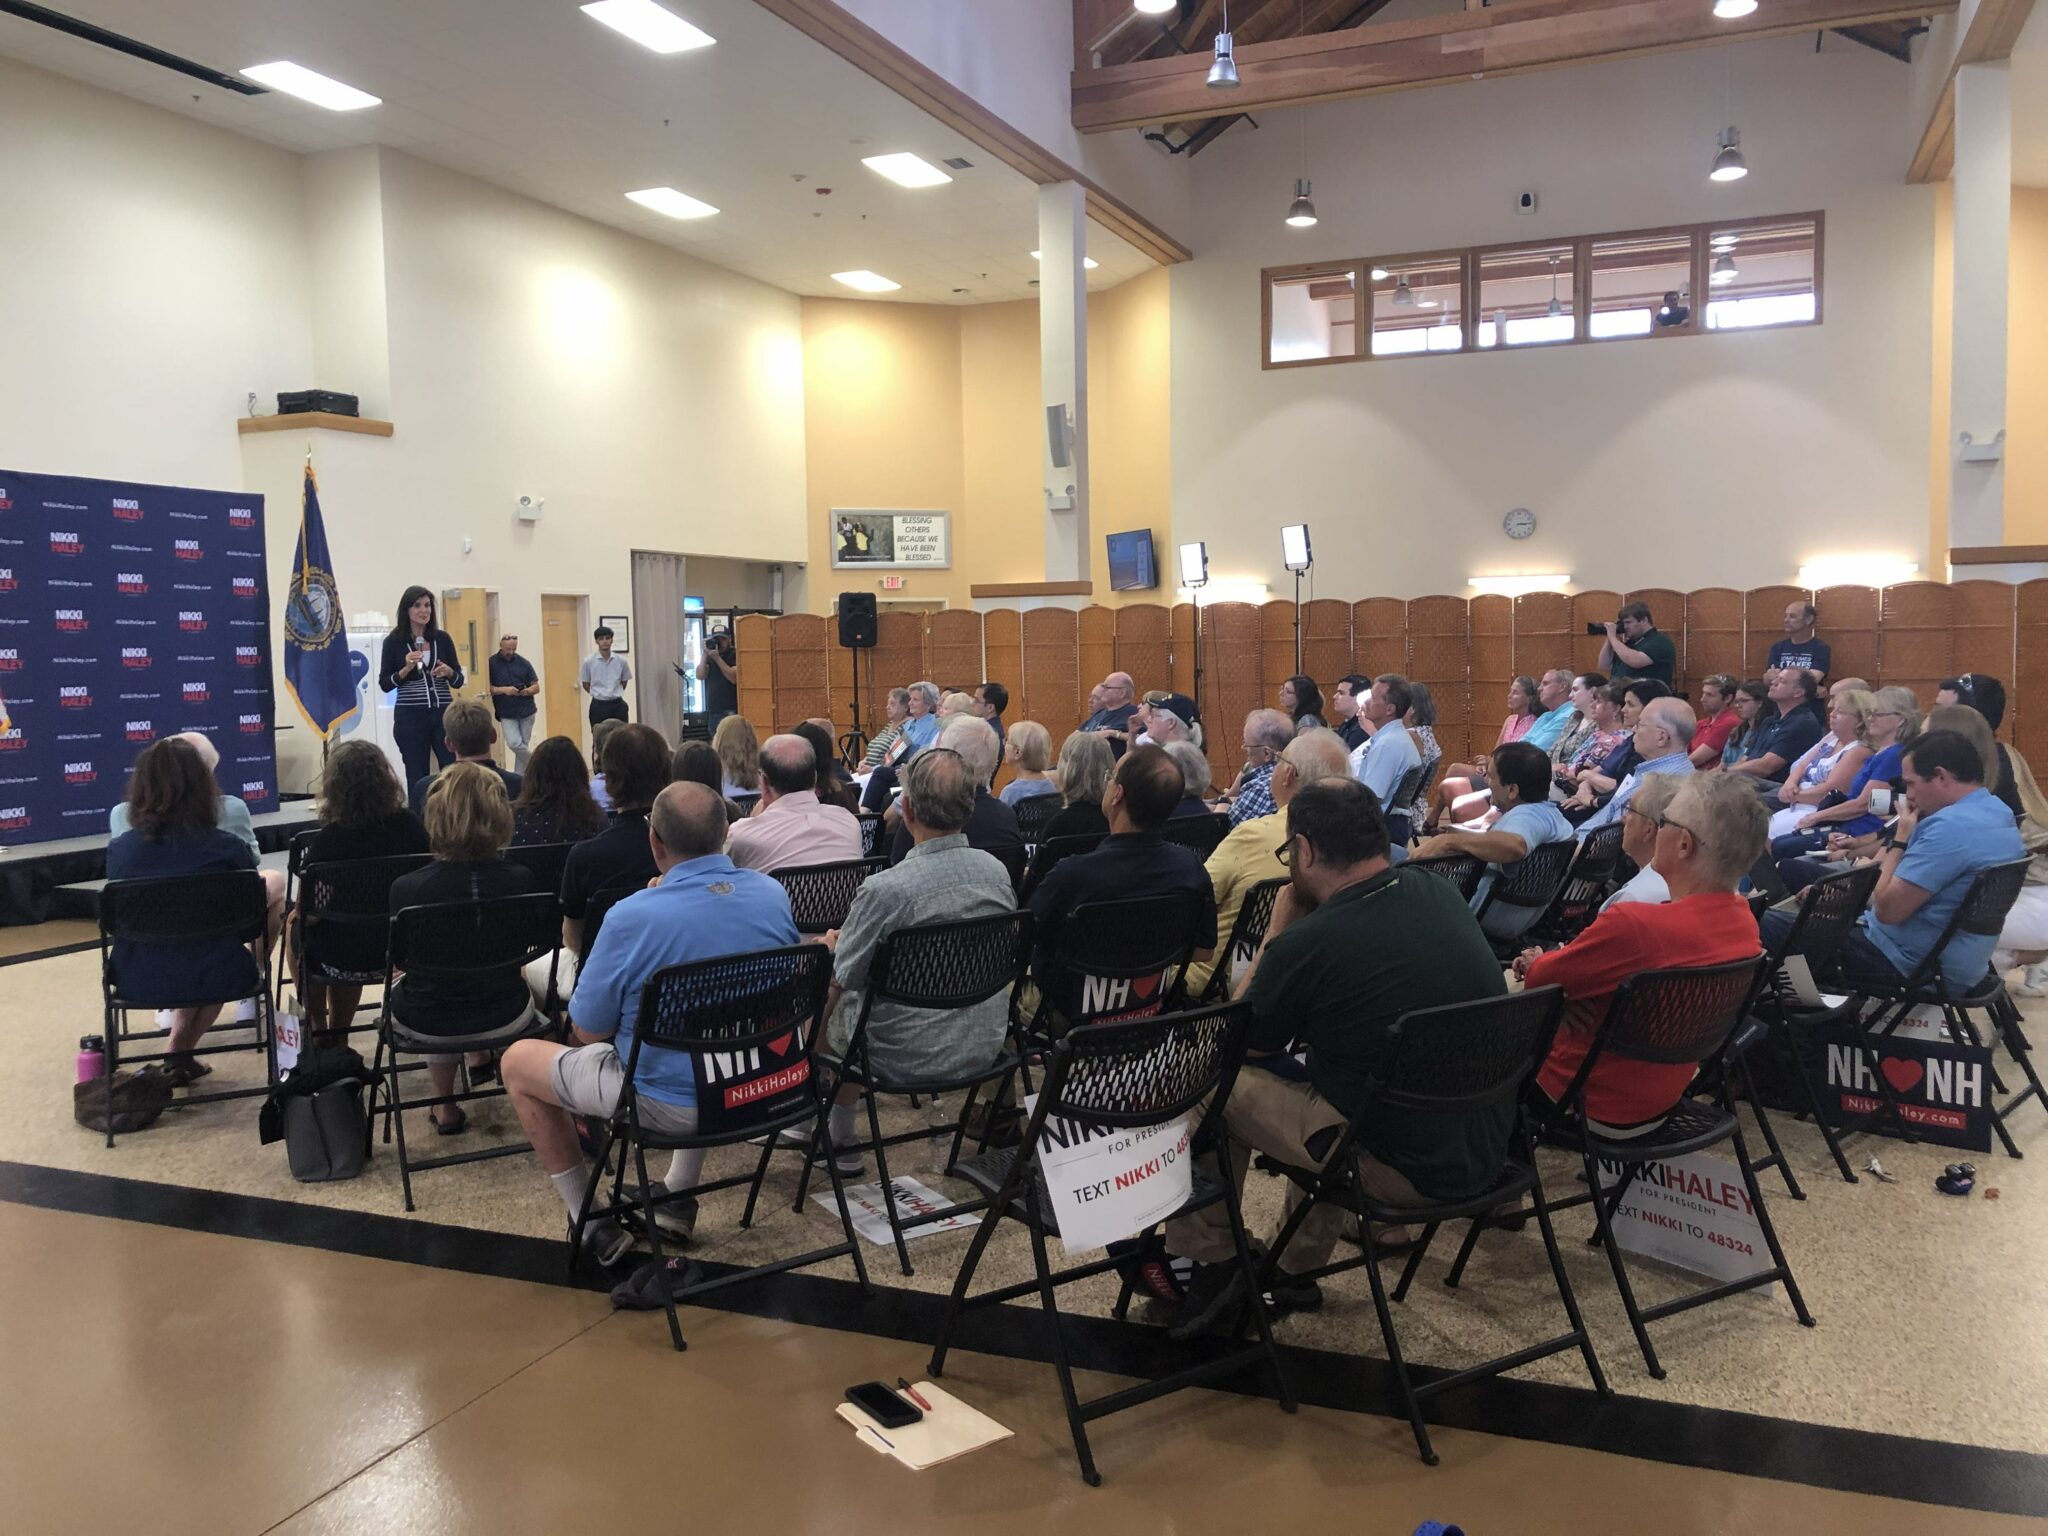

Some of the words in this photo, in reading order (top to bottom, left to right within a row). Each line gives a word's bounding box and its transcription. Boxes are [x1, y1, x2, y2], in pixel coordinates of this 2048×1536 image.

[113, 498, 138, 509] NIKKI
[112, 509, 144, 519] HALEY
[229, 508, 251, 518] NIKKI
[229, 518, 256, 527] HALEY
[902, 516, 933, 524] BLESSING
[905, 526, 930, 534] OTHERS
[50, 532, 78, 543] NIKKI
[897, 535, 926, 543] BECAUSE
[928, 535, 938, 543] WE
[51, 543, 84, 554] HALEY
[175, 540, 199, 550] NIKKI
[900, 544, 918, 552] HAVE
[920, 544, 936, 552] BEEN
[175, 550, 204, 559] HALEY
[905, 553, 931, 561] BLESSED
[118, 573, 143, 584] NIKKI
[232, 578, 254, 587] NIKKI
[886, 576, 900, 588] EXIT
[117, 583, 148, 593] HALEY
[232, 587, 259, 596] HALEY
[56, 609, 83, 620] NIKKI
[179, 611, 202, 621] NIKKI
[56, 620, 89, 630] HALEY
[179, 621, 208, 630] HALEY
[122, 648, 147, 657] NIKKI
[236, 647, 257, 655] NIKKI
[122, 657, 152, 667] HALEY
[236, 656, 262, 665] HALEY
[60, 687, 88, 697] NIKKI
[183, 682, 206, 692] NIKKI
[61, 696, 93, 707] HALEY
[183, 692, 211, 701] HALEY
[239, 714, 261, 724] NIKKI
[126, 721, 151, 731] NIKKI
[239, 723, 265, 733] HALEY
[127, 730, 156, 740] HALEY
[64, 762, 92, 773] NIKKI
[64, 771, 97, 783] HALEY
[243, 781, 264, 792] NIKKI
[243, 789, 269, 800] HALEY
[1082, 974, 1131, 1014] NH
[732, 1064, 810, 1103] NikkiHaley.c
[1926, 1057, 1982, 1108] NH
[1108, 1139, 1132, 1155] FOR
[1136, 1120, 1172, 1144] PRESID
[1073, 1180, 1111, 1204] TEXT
[1115, 1157, 1161, 1190] NIKKI
[1161, 1148, 1176, 1168] TO
[1640, 1187, 1659, 1199] FOR
[1663, 1193, 1717, 1216] PRESIDENT
[1617, 1204, 1638, 1219] EXT
[1642, 1210, 1683, 1233] NIKKI
[1686, 1223, 1704, 1239] TO
[1707, 1231, 1753, 1256] 48324
